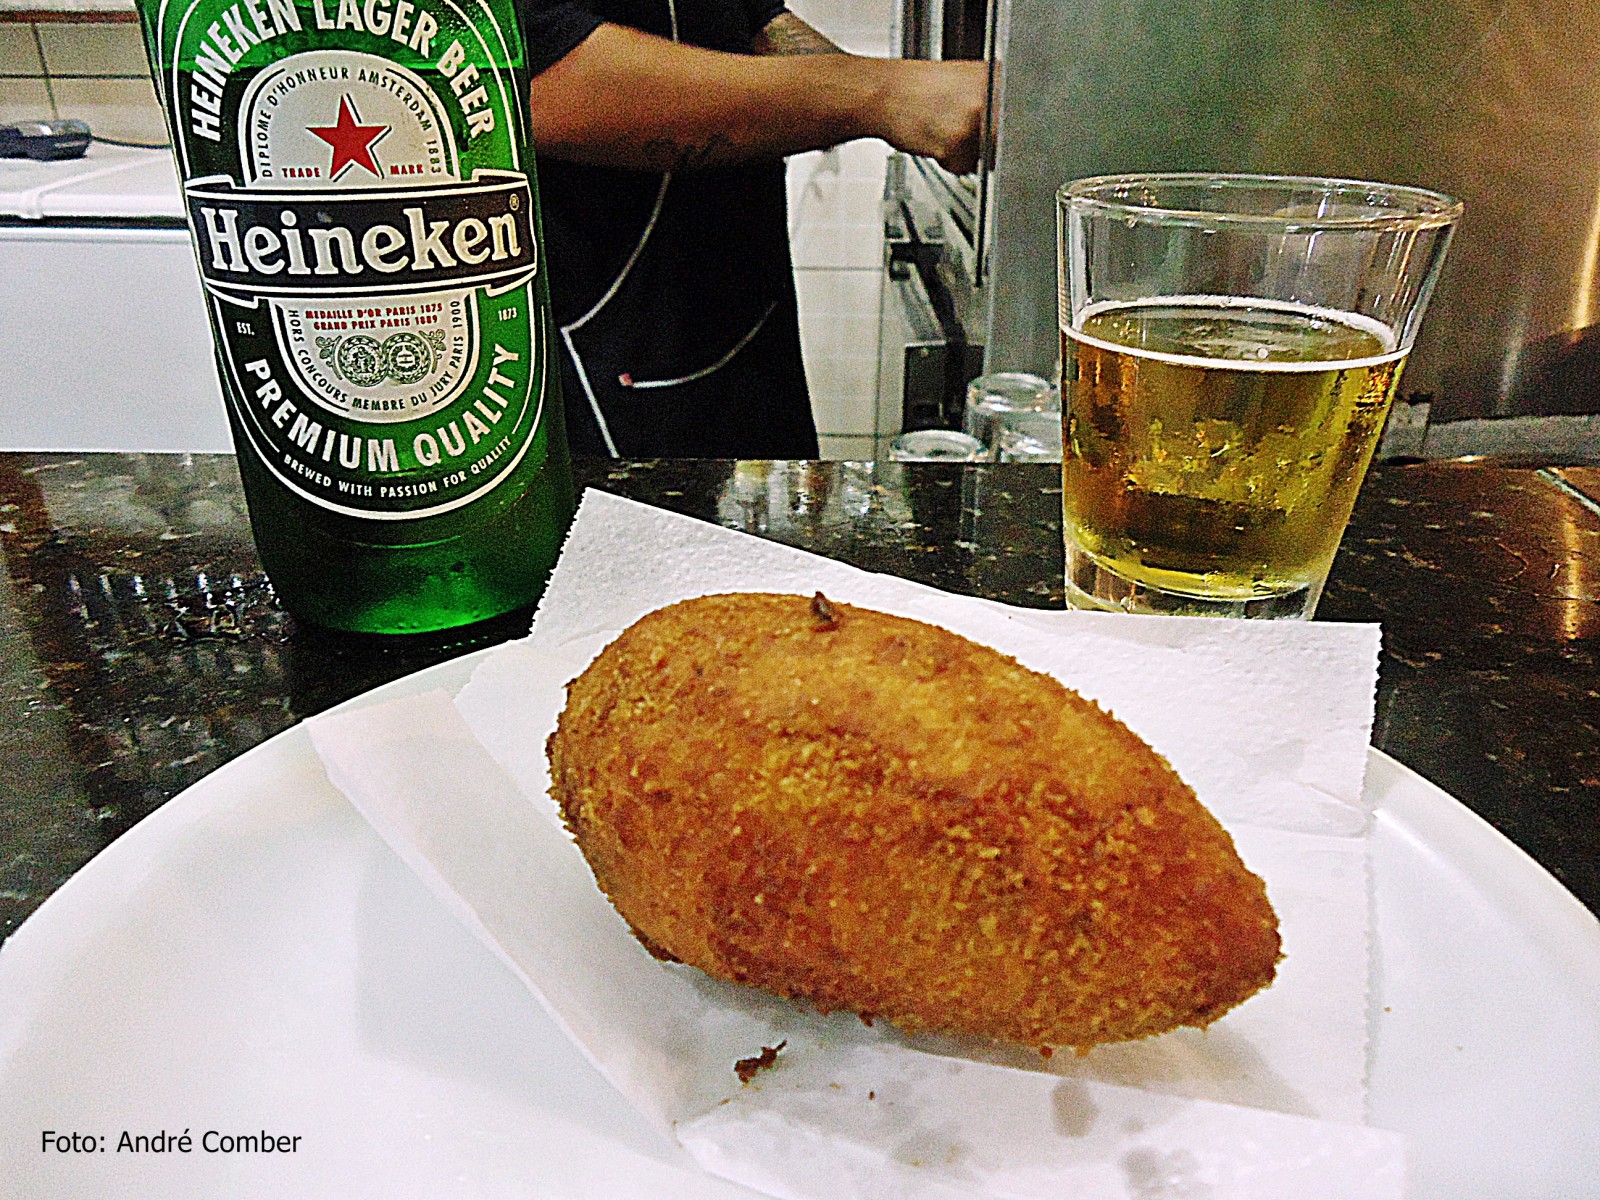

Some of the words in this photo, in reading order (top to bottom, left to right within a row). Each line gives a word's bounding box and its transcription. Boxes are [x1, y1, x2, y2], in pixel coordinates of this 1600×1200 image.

[192, 0, 302, 142] HEINEKEN
[315, 0, 439, 58] LAGER
[436, 40, 496, 140] BEER
[257, 110, 273, 177] DIPLOME
[267, 67, 349, 108] D'HONNEUR
[358, 68, 432, 131] AMSTERDAM
[426, 140, 441, 174] 1883
[282, 168, 320, 178] TRADE
[390, 164, 424, 175] MARK
[200, 207, 522, 275] Heineken
[305, 310, 354, 319] MEDAILLE
[357, 308, 382, 318] D'OR
[386, 305, 416, 316] PARIS
[420, 303, 443, 313] 1875
[313, 321, 348, 330] GRAND
[352, 320, 376, 329] PRIX
[380, 318, 411, 328] PARIS
[415, 315, 438, 325] 1889
[450, 300, 462, 329] 1900
[498, 307, 517, 321] 1873
[236, 321, 255, 335] EST.
[288, 309, 305, 343] HORS
[450, 336, 464, 369] PARIS
[297, 349, 348, 403] CONCOURS
[429, 371, 453, 397] JURY
[245, 358, 399, 472] PREMIUM
[413, 344, 520, 467] QUALITY
[352, 397, 406, 411] MEMBRE
[411, 392, 428, 406] DU
[284, 453, 332, 487] BREWED
[338, 480, 372, 497] WITH
[380, 479, 437, 498] PASSION
[443, 471, 467, 488] FOR
[470, 436, 512, 475] QUALITY
